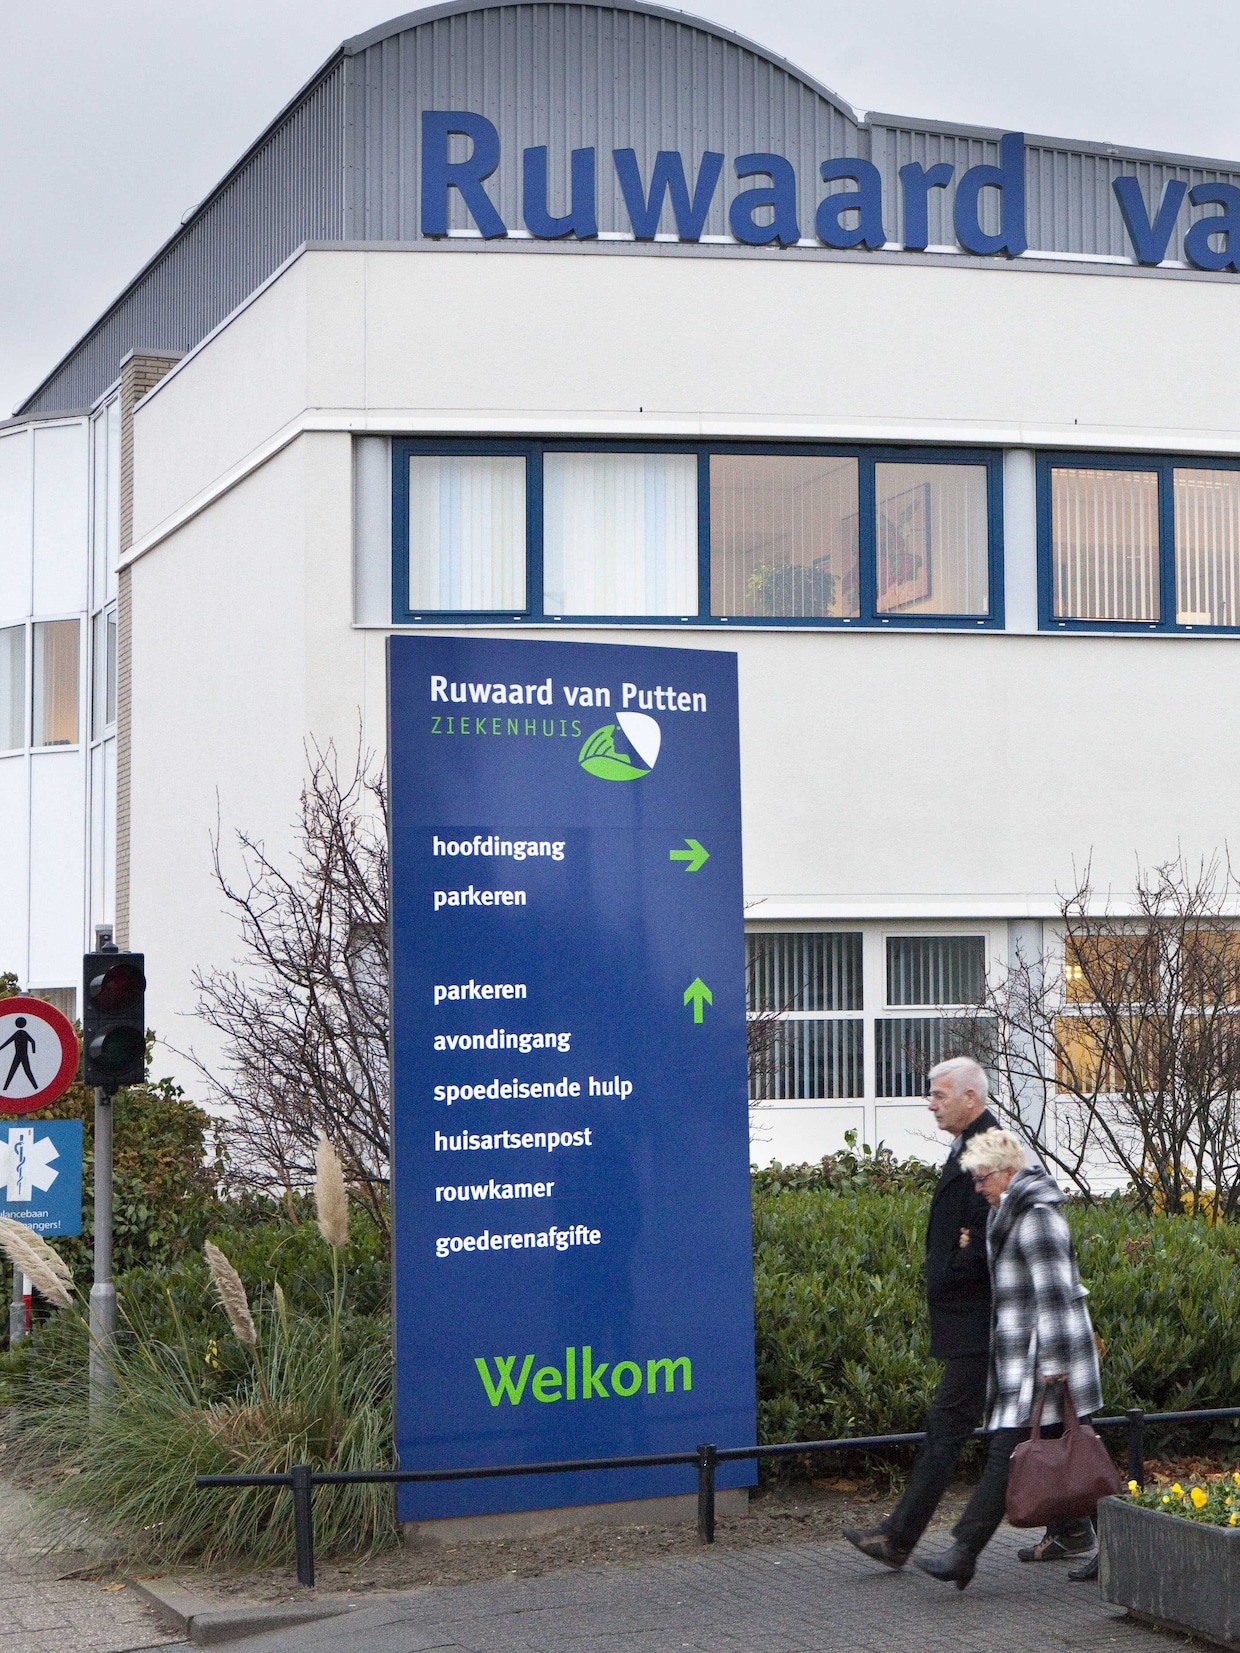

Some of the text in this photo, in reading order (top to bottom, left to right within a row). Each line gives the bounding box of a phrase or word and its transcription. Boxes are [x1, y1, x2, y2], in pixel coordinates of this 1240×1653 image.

[421, 111, 1028, 259] Ruwaard
[431, 675, 707, 712] Ruwaard van Putten
[431, 716, 582, 738] ZIEKENHUIS
[433, 835, 566, 861] hoofdingang
[434, 884, 527, 911] parkeren
[434, 979, 527, 1005] parkeren
[434, 1028, 572, 1053] avondingang
[434, 1075, 633, 1105] spoedeisende hulp
[435, 1127, 593, 1152] huisartsenpost
[435, 1178, 555, 1202] rouwkamer
[24, 1220, 61, 1231] angers!
[435, 1225, 601, 1257] goederenafgifte
[475, 1345, 693, 1407] Welkom
